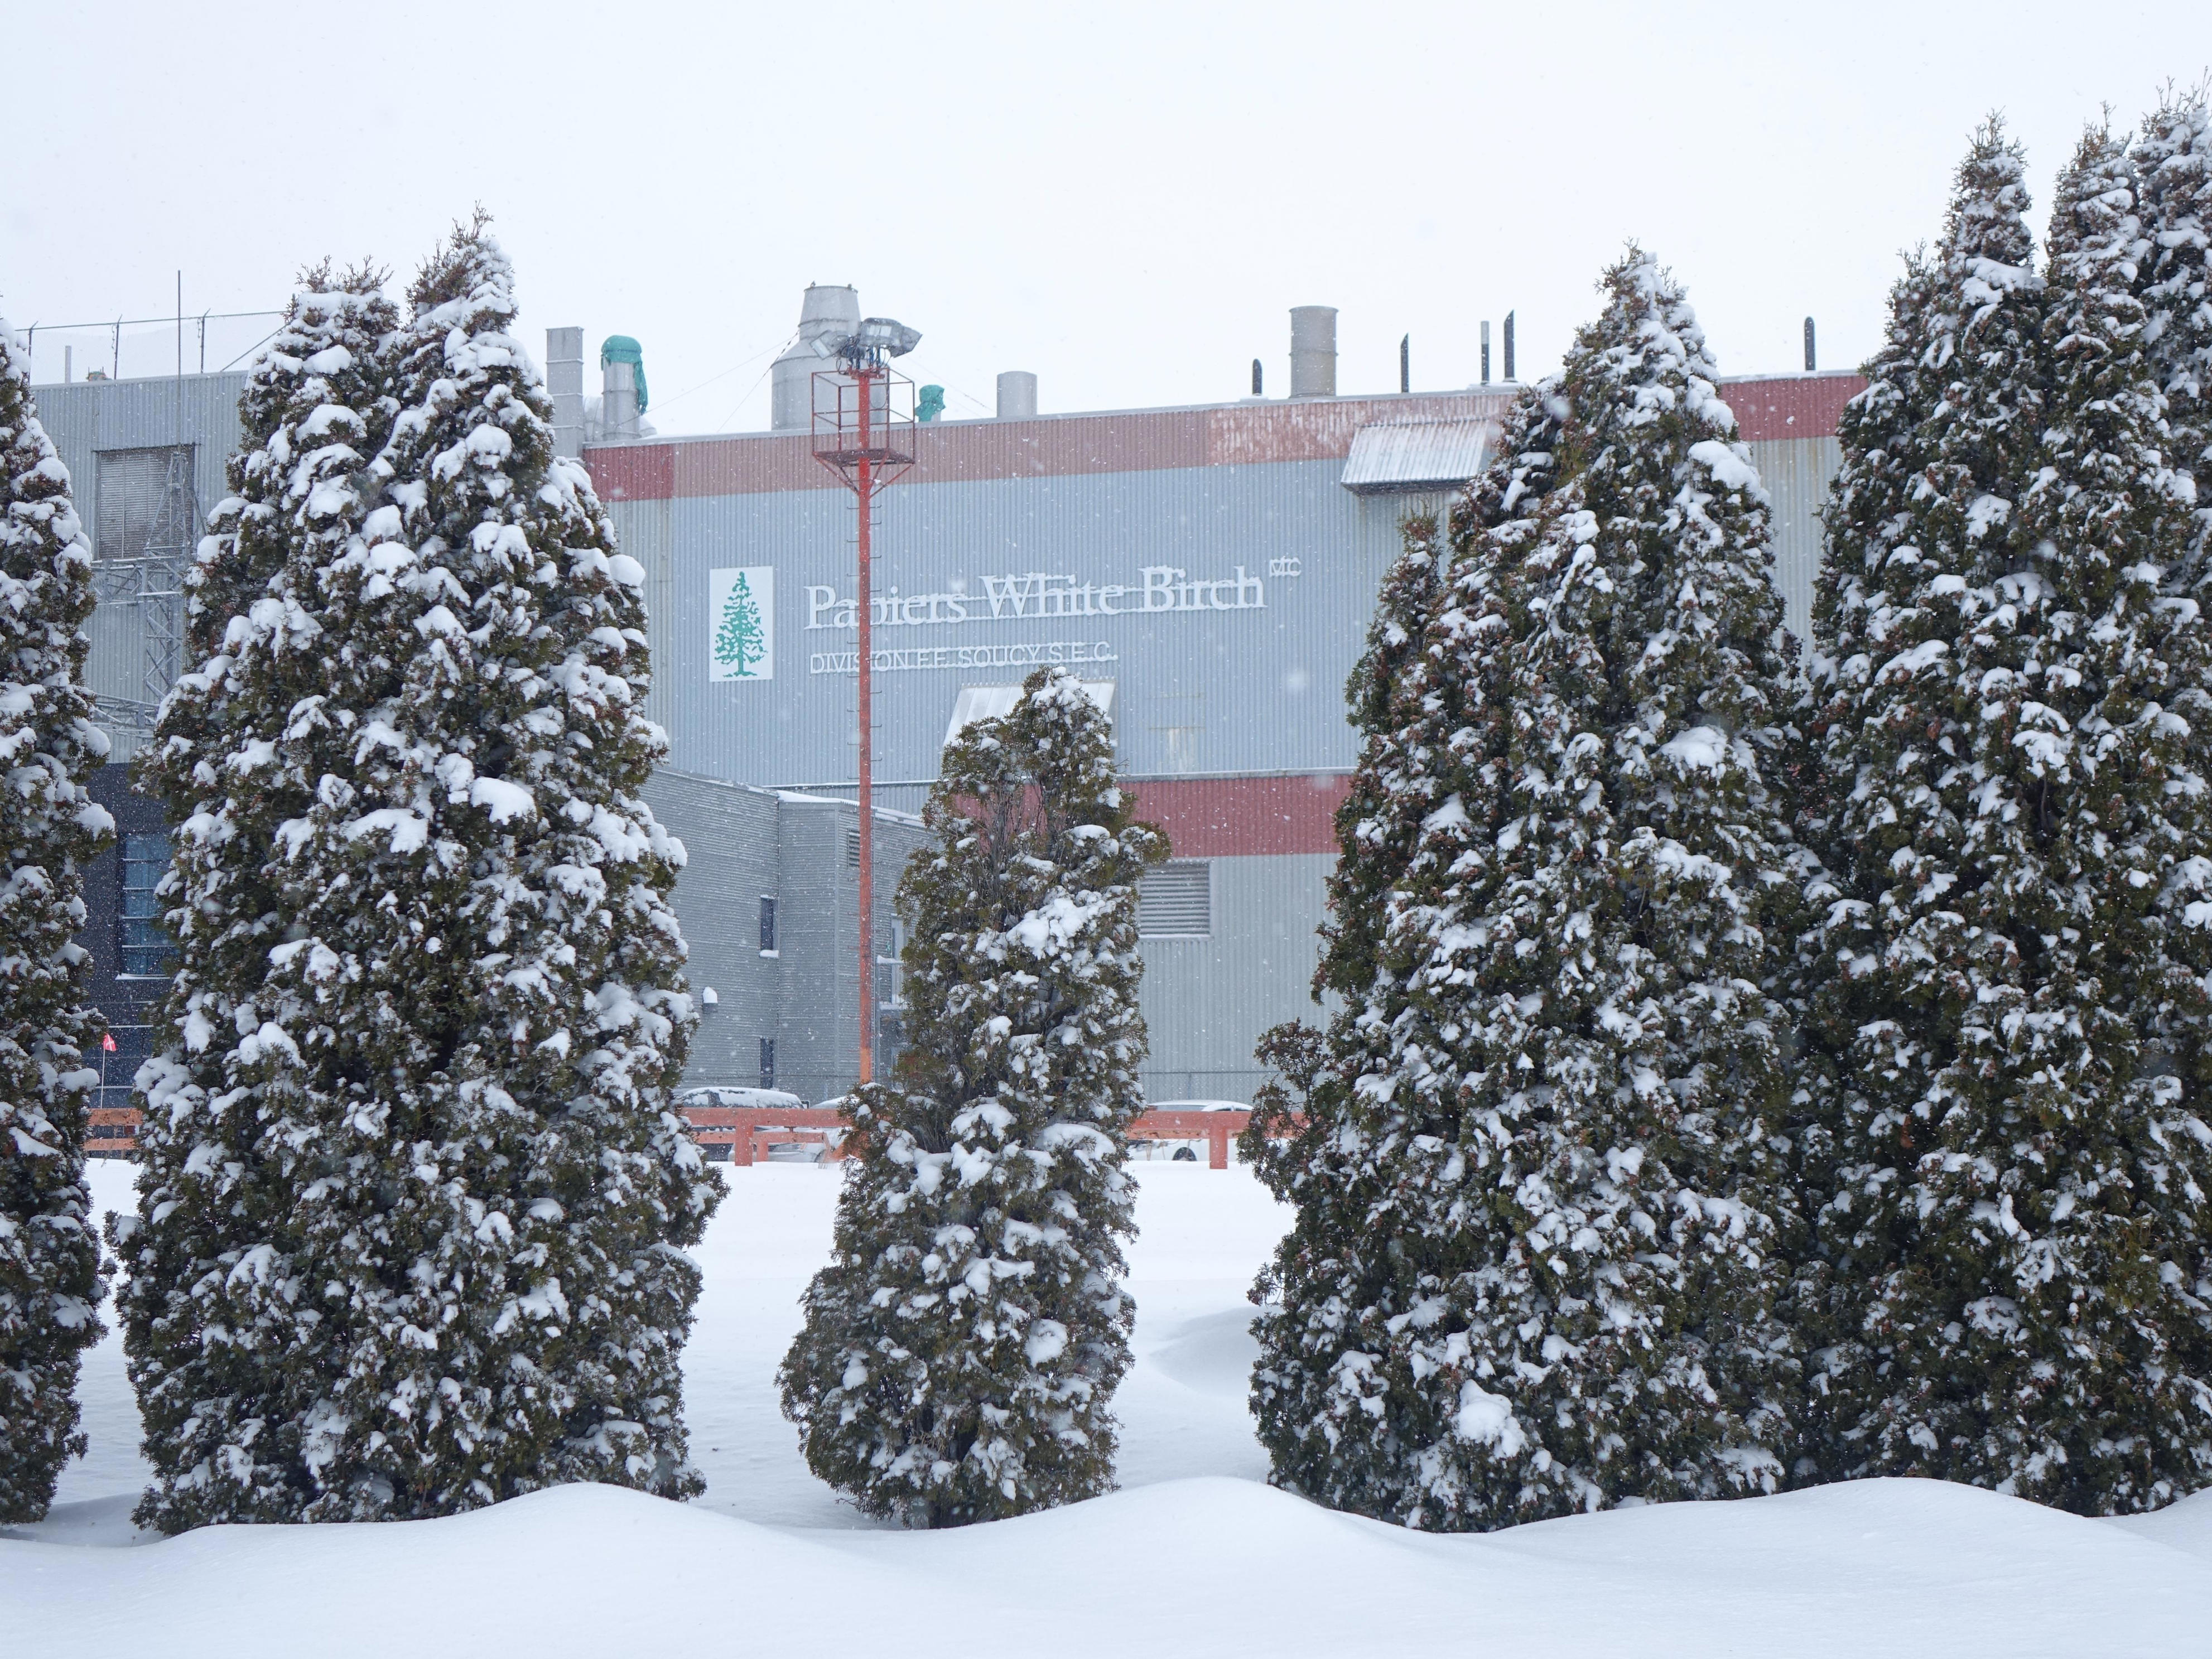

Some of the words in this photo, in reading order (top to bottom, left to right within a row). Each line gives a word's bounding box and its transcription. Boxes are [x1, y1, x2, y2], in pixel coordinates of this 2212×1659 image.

[978, 572, 1124, 620] White
[1138, 565, 1268, 612] Birch
[1269, 556, 1302, 577] MC
[958, 645, 1040, 668] SOUCY
